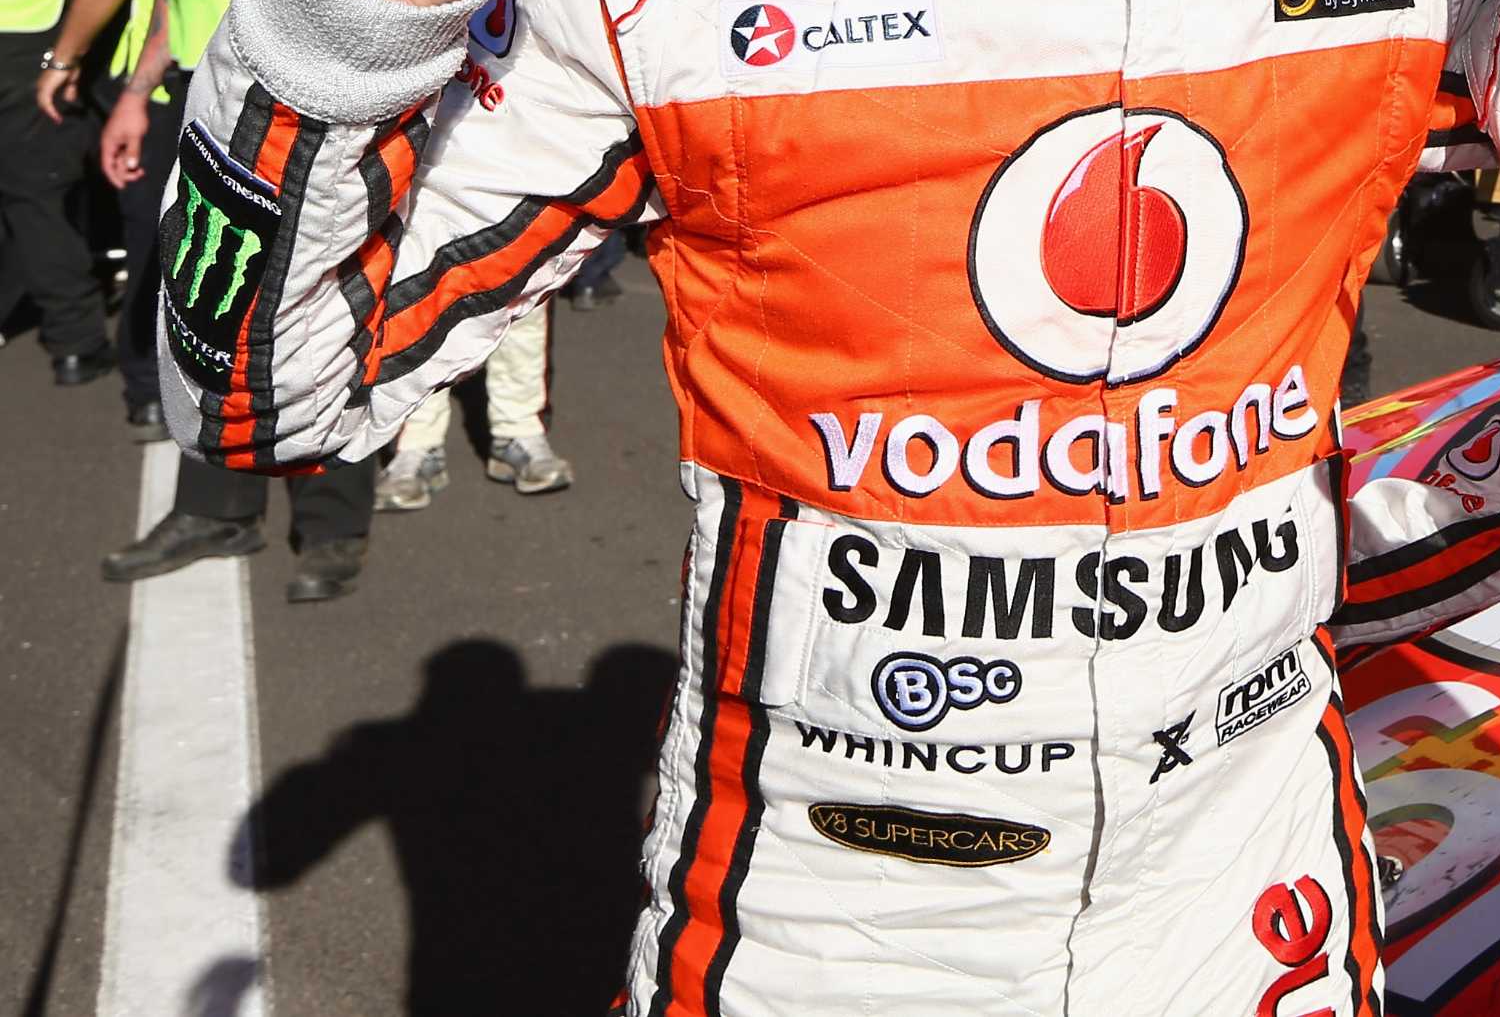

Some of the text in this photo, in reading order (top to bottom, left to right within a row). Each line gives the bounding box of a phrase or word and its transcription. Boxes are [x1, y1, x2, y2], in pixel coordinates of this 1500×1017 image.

[802, 9, 931, 51] CALTEX
[809, 364, 1319, 505] vodafone
[822, 503, 1300, 641] SAMSUNG
[1220, 677, 1308, 743] RACEWEAR
[1224, 650, 1297, 718] rpm
[795, 720, 1076, 775] WHINCUP
[817, 811, 1038, 852] V8 SUPERCARS
